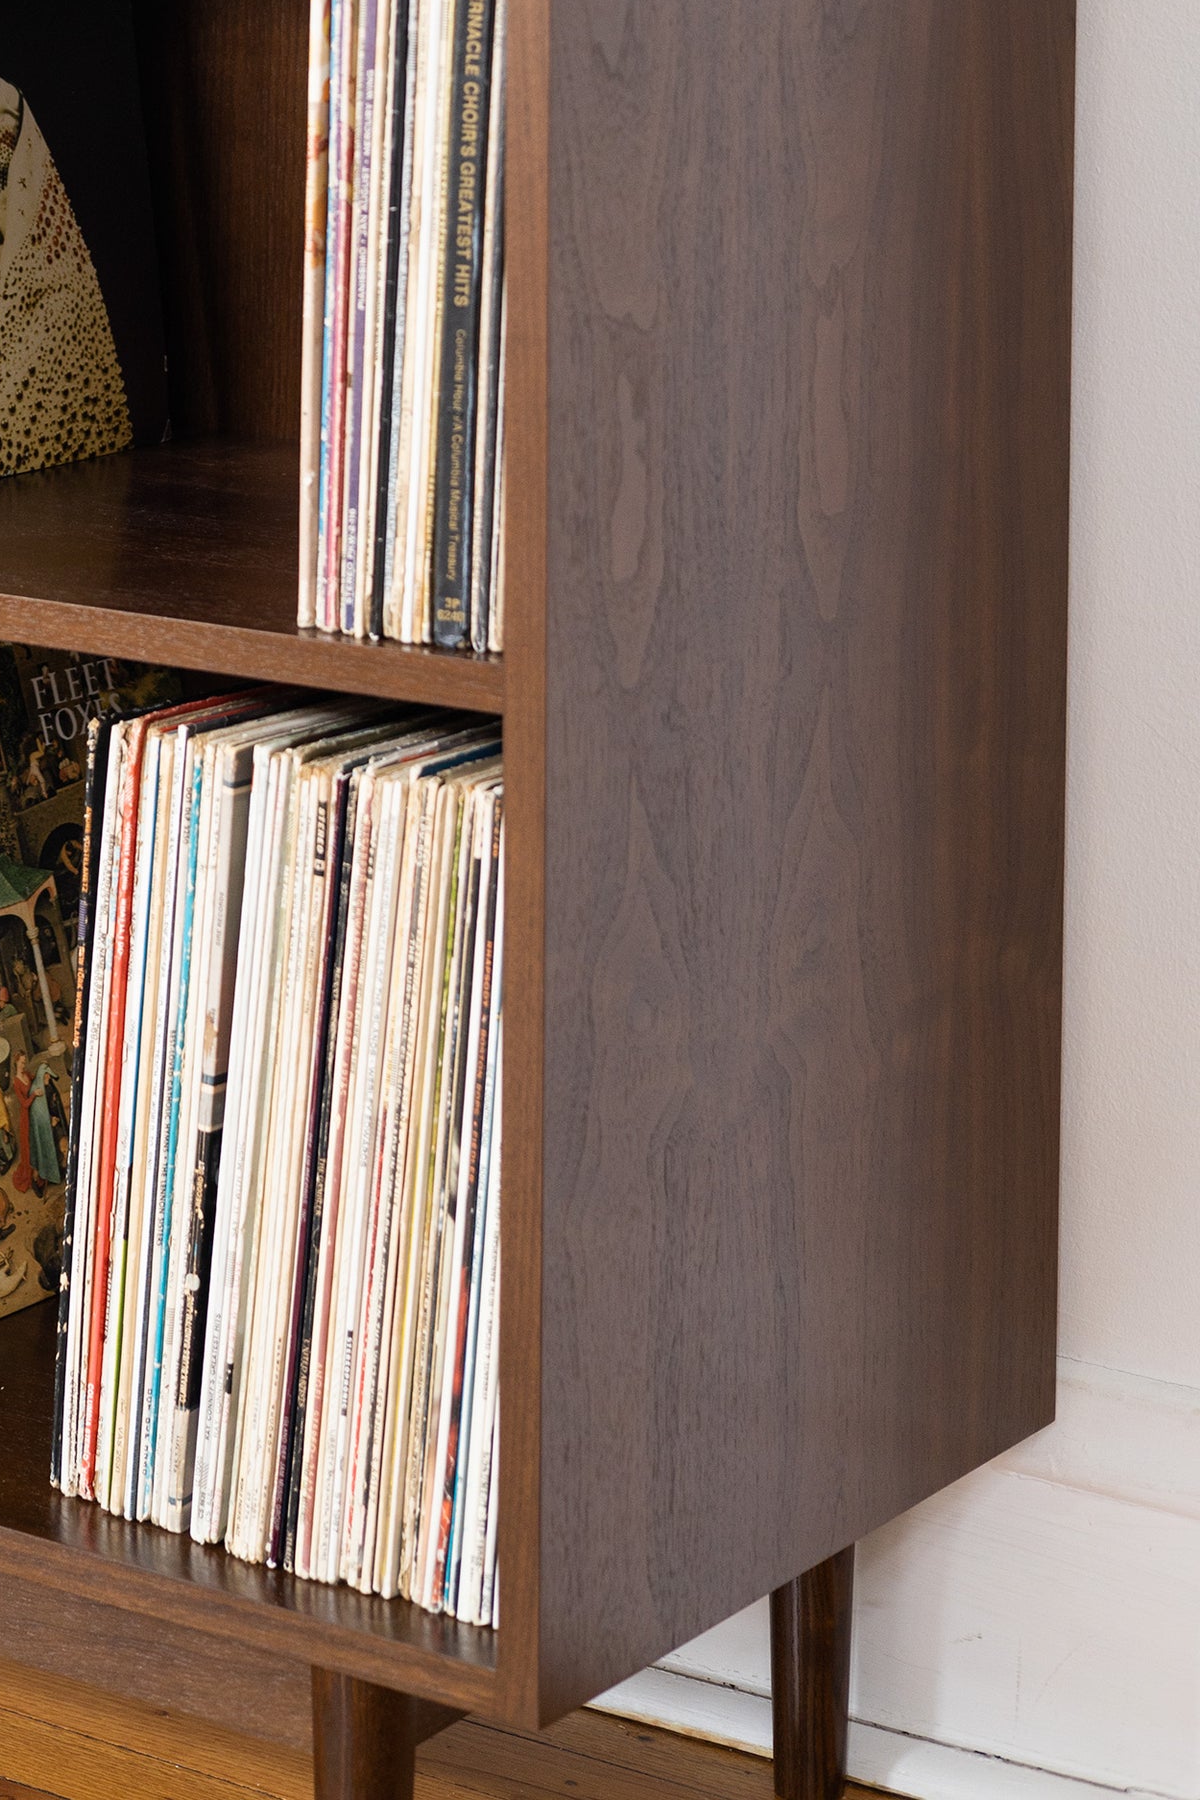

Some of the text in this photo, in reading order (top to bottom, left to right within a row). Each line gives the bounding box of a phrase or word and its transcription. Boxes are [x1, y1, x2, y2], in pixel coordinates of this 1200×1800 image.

[361, 103, 373, 156] MERCURY
[460, 81, 481, 157] CHOIR'S
[359, 166, 370, 213] AUGUST
[455, 162, 477, 259] GREATEST
[358, 216, 368, 236] JAN
[357, 246, 368, 311] PIANISSIMO
[453, 264, 472, 306] HITS
[444, 328, 467, 580] Columbia Columbia Musical Treasury
[30, 658, 116, 709] FLEET
[315, 806, 328, 854] STEREO
[72, 836, 91, 1048] KOSTELANETZ YORK WONDERLAND
[215, 891, 226, 946] SIRE RECORDS
[467, 940, 494, 1184] RHAPSODY BOSTON POPS FIEDLER
[156, 1030, 177, 1246] BEST-LOVED CATHOLIC HYMNS THE LENNON SISTERS
[318, 1157, 327, 1176] THE
[214, 1312, 222, 1332] HITS
[82, 1382, 95, 1460] COLUMBIA STEREO
